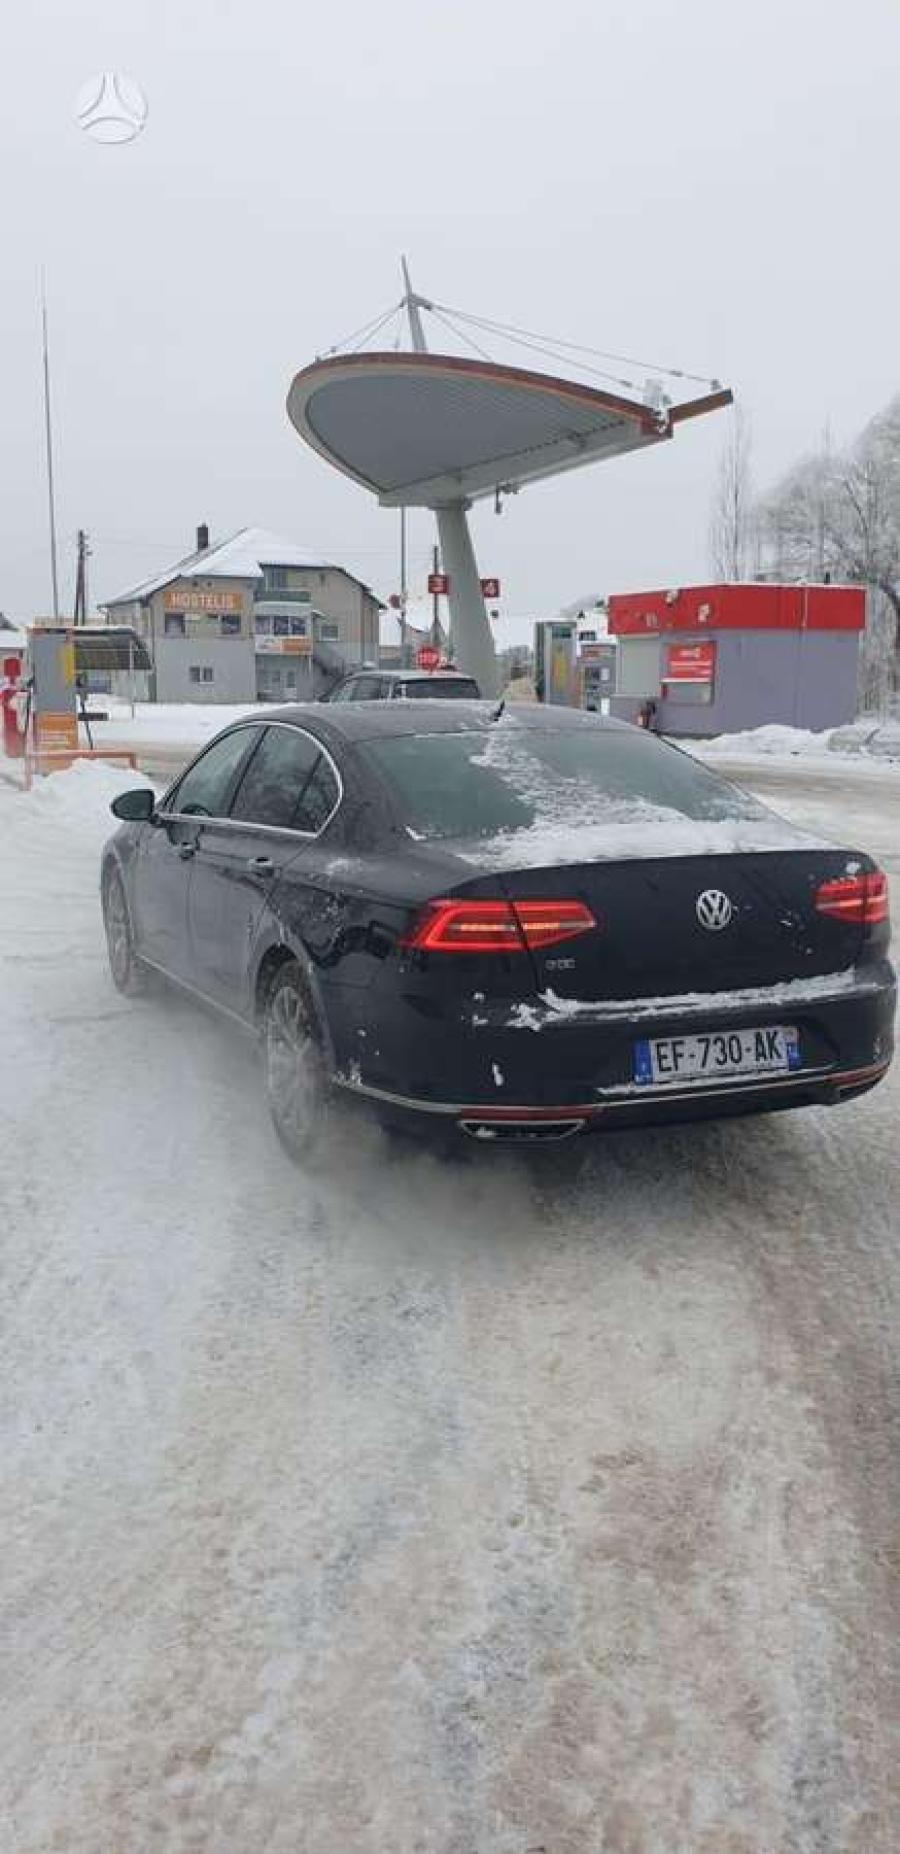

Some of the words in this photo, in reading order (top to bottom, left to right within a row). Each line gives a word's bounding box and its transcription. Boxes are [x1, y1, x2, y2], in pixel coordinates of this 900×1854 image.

[485, 581, 496, 595] 4
[170, 593, 235, 609] HOSTELIS
[420, 651, 440, 663] STOP
[655, 1031, 782, 1072] EF-730-AK
